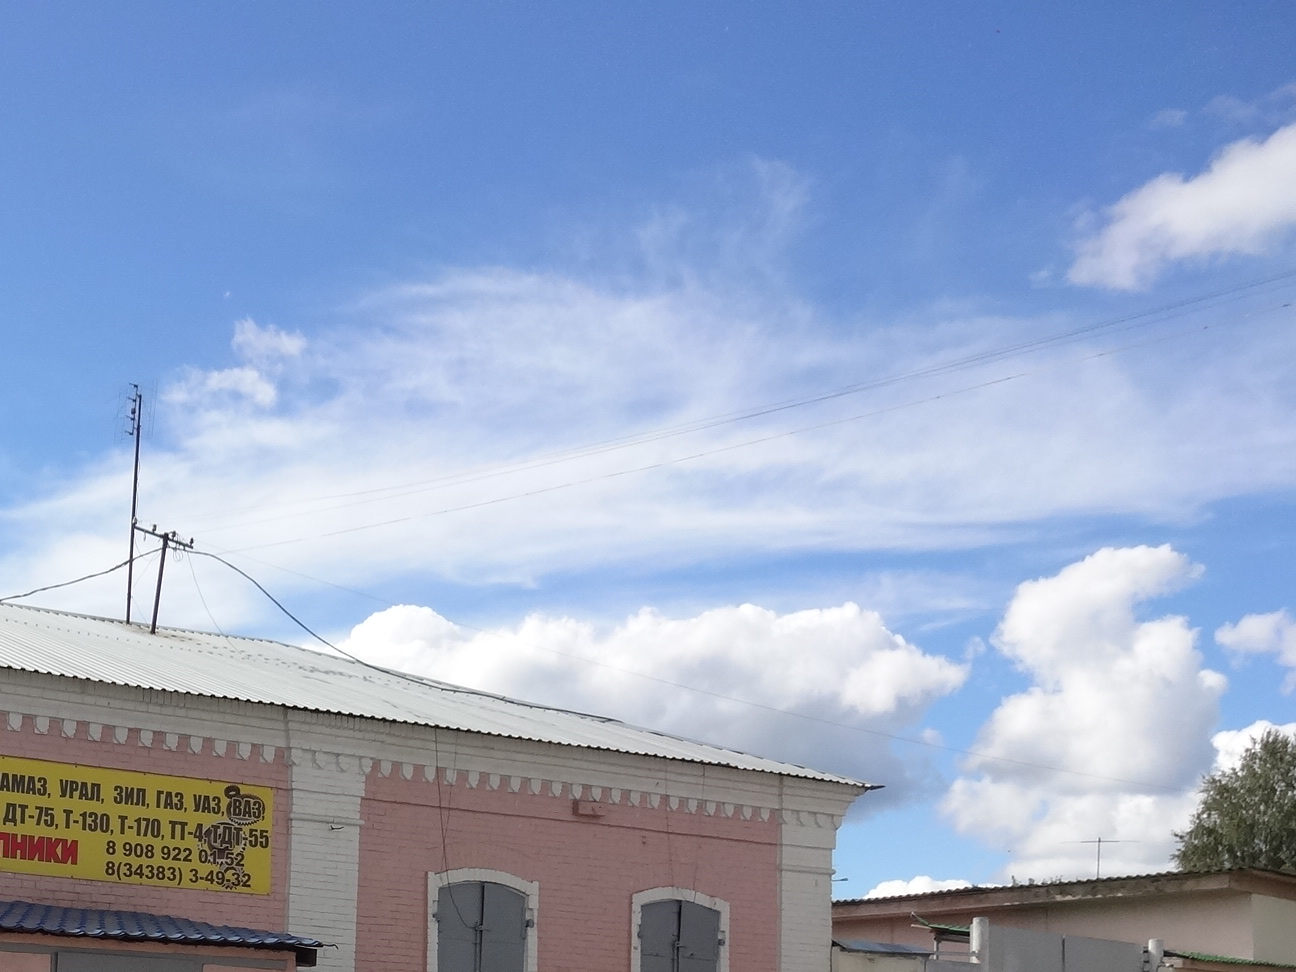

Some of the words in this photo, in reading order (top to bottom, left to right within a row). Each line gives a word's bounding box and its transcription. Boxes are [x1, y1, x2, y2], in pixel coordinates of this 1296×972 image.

[59, 779, 104, 804] УРАЛ,
[113, 785, 149, 809] ЗИЛ,
[156, 790, 187, 813] ГАЗ,
[193, 794, 224, 816] УАЗ,
[232, 798, 265, 821] ВАЗ,
[3, 803, 59, 830] ДТ-75,
[63, 809, 114, 835] Т-130,
[118, 815, 165, 840] Т-170,
[211, 824, 269, 849] ТДТ-55
[106, 840, 116, 855] 8
[122, 842, 154, 859] 908
[161, 845, 192, 862] 922
[198, 849, 217, 864] 01
[225, 852, 244, 867] 52
[105, 861, 183, 885] 8(34383)
[189, 868, 251, 887] 3-49-32
